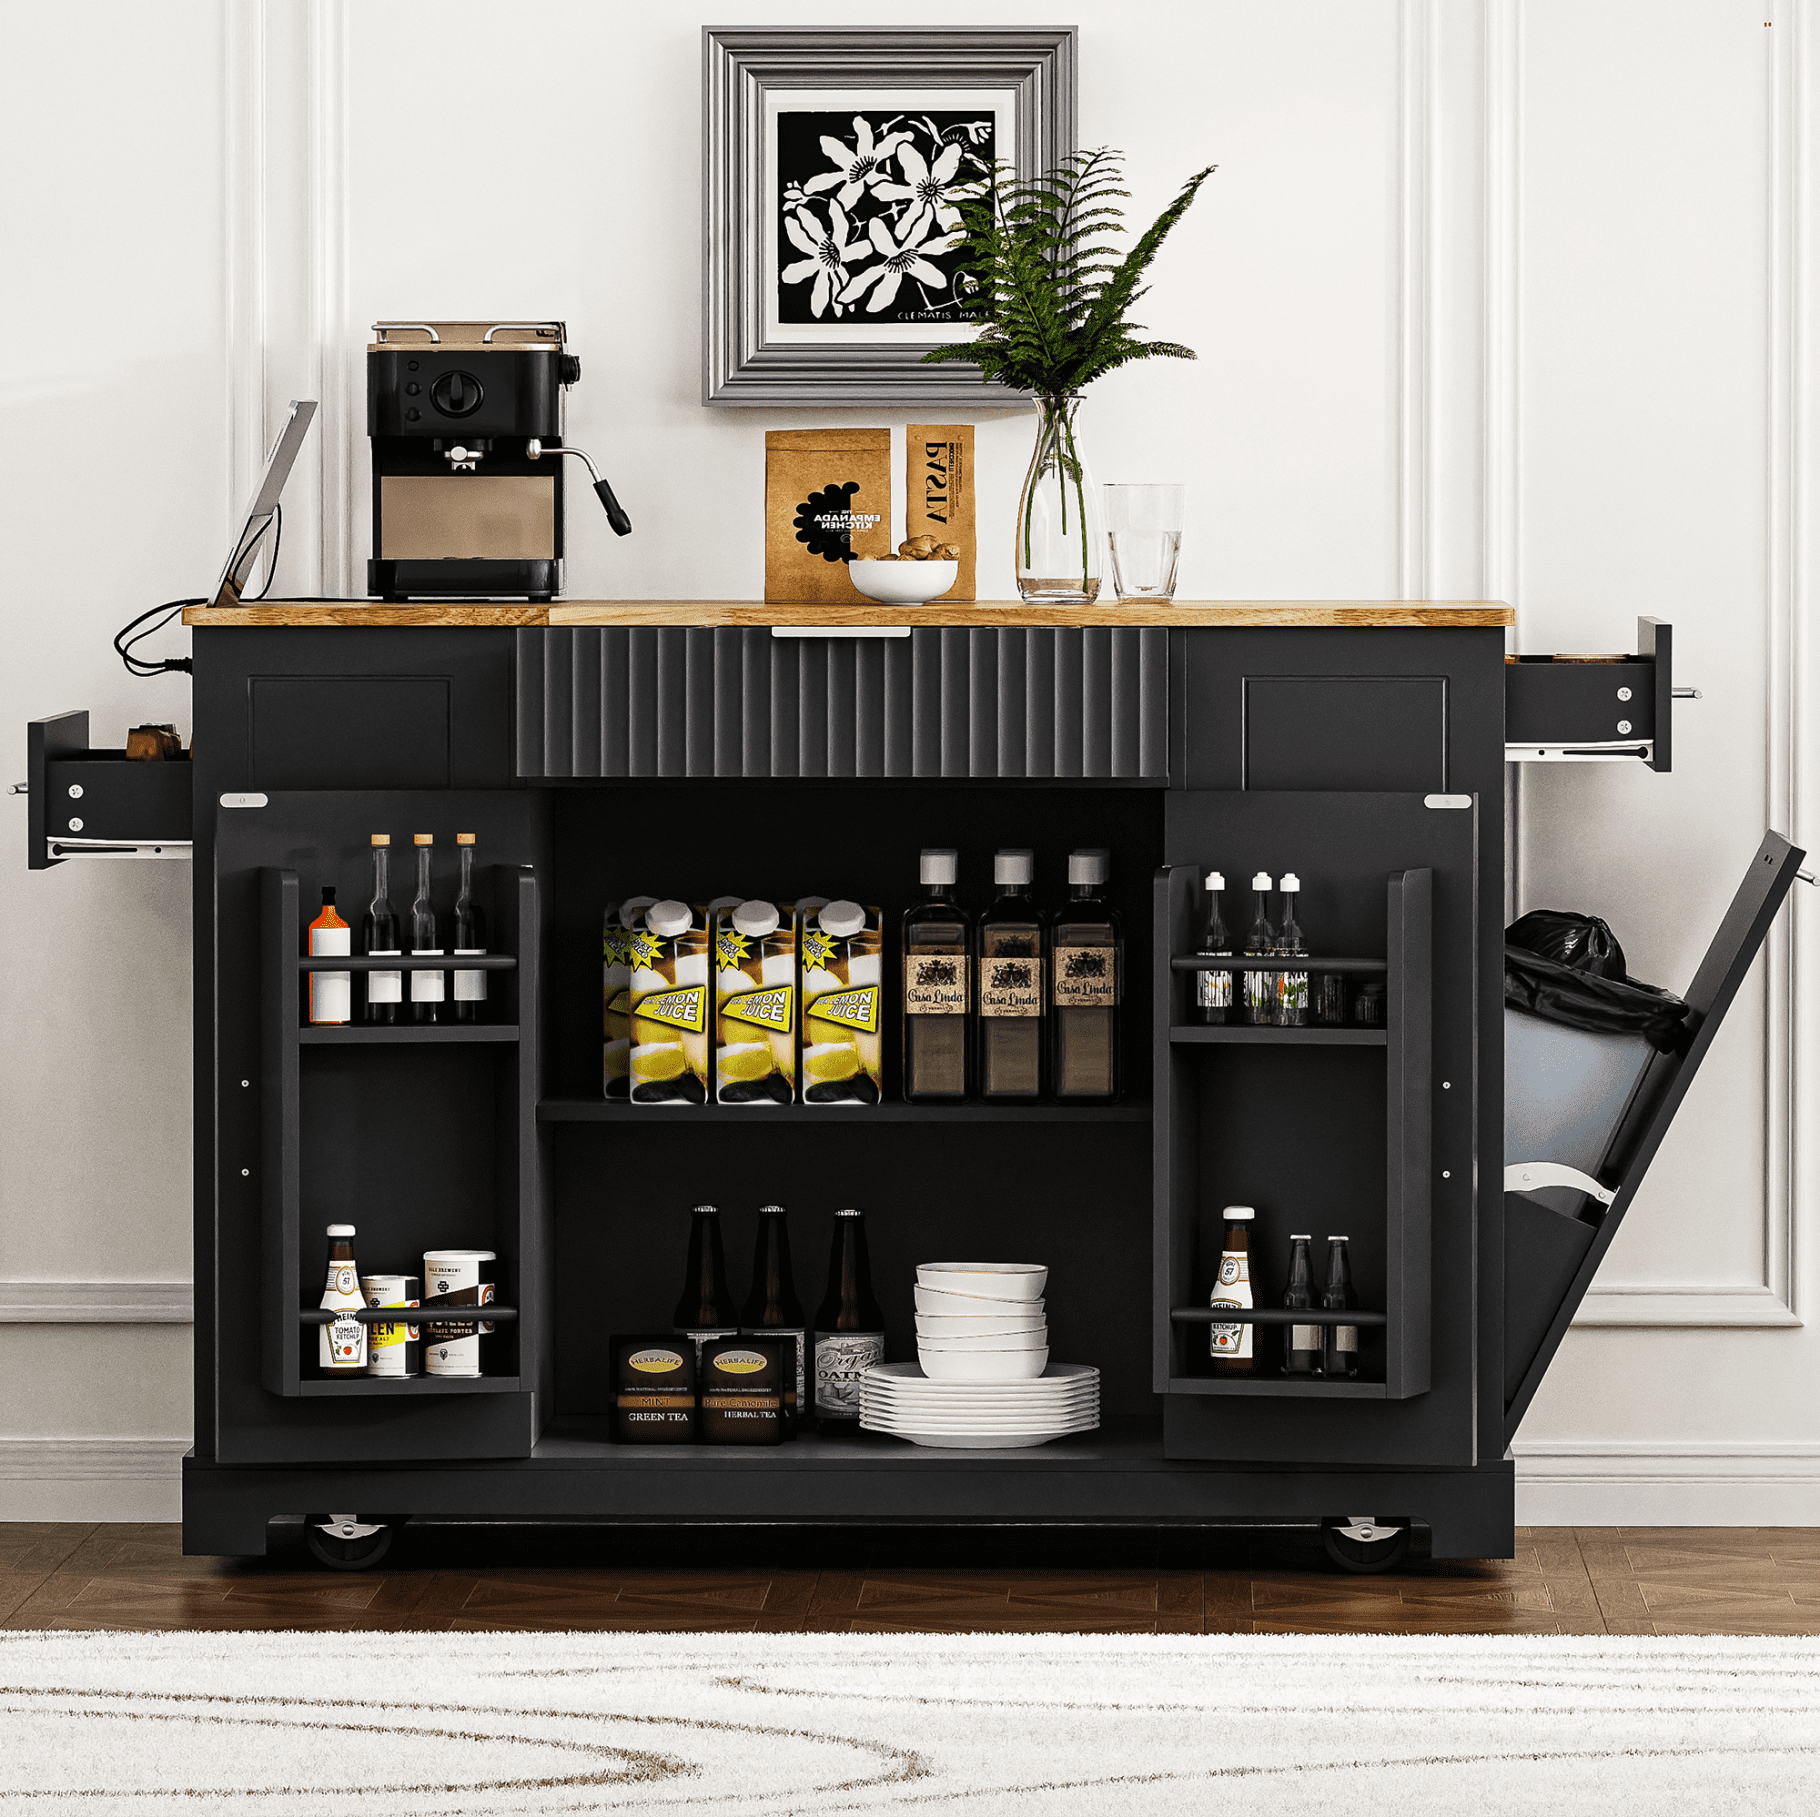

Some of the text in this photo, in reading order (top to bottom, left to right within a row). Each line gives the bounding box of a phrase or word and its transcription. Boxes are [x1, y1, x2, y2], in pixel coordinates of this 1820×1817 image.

[897, 311, 951, 320] CLEMATIS
[1057, 981, 1112, 995] Casa Linda
[656, 991, 700, 1004] LEMON
[743, 991, 786, 1004] LEMON
[829, 991, 873, 1004] LEMON
[908, 989, 963, 1004] Casa Linda
[983, 992, 1037, 1006] Casa Linda
[653, 1004, 697, 1022] JUICE
[740, 1004, 784, 1022] JUICE
[827, 1004, 871, 1022] JUICE
[334, 1326, 360, 1334] TOMATO
[631, 1357, 680, 1366] HERBALIFE
[715, 1358, 765, 1366] HERBALIFE
[641, 1397, 671, 1405] MINT
[729, 1398, 777, 1407] Camomile
[628, 1413, 688, 1421] GREEN TEA
